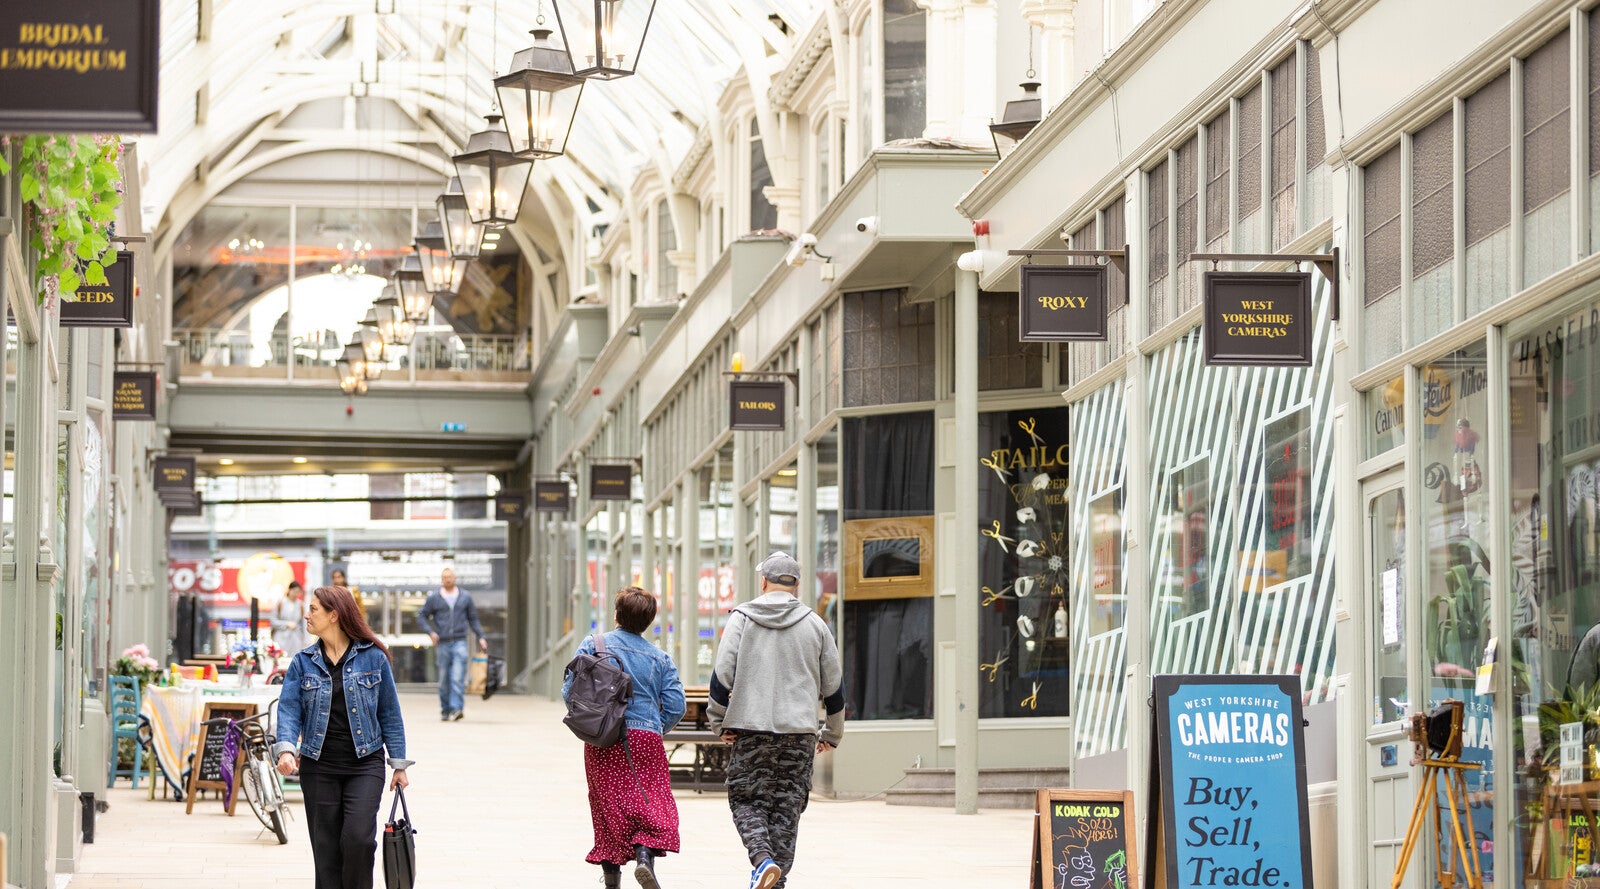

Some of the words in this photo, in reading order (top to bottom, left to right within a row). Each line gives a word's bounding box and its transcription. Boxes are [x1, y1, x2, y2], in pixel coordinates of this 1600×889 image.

[20, 23, 109, 47] BRIDAL
[0, 48, 127, 73] EMPORIUM
[77, 290, 115, 303] EEDS
[1038, 296, 1088, 310] ROXY
[1241, 300, 1274, 311] WEST
[1221, 313, 1293, 325] YORKSHIRE
[1227, 326, 1287, 338] CAMERAS
[739, 401, 777, 411] TAILORS
[1184, 697, 1212, 710] WEST
[1219, 696, 1279, 709] YORKSHIRE
[1177, 711, 1289, 747] CAMERAS
[1187, 751, 1201, 760] THE
[1204, 755, 1232, 763] PROPER
[1235, 756, 1264, 764] CAMERA
[1266, 752, 1283, 761] SHOP
[1183, 776, 1258, 811] Buy,
[1055, 804, 1091, 817] KODAK
[1077, 817, 1113, 833] SOLD
[1185, 815, 1260, 851] Sell,
[1186, 856, 1291, 888] Trade.
